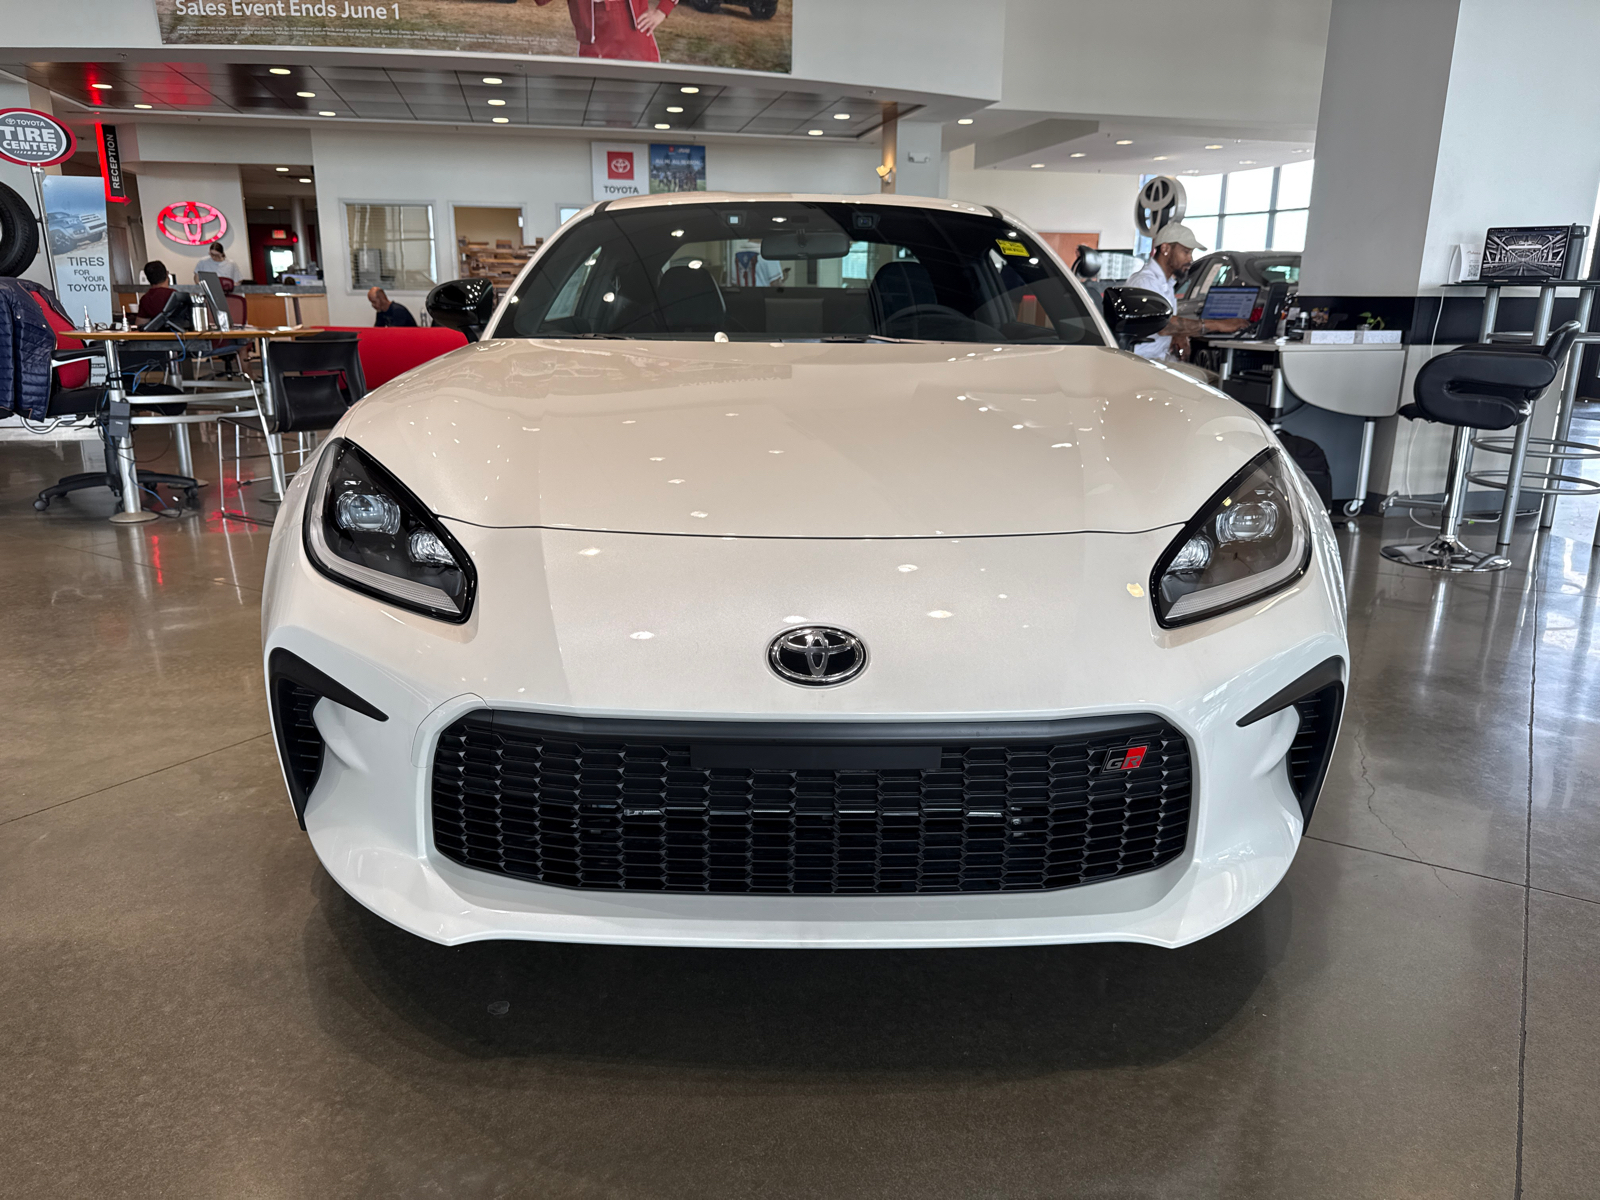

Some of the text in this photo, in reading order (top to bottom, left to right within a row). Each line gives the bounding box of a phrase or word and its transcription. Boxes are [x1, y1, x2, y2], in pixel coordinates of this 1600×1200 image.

[175, 0, 399, 20] Sales Event Ends June 1
[16, 119, 46, 127] TOYOTA
[0, 126, 57, 143] TIRE
[2, 140, 58, 152] CENTER
[106, 134, 121, 189] RECEPTION
[604, 185, 639, 195] TOYOTA
[67, 256, 105, 267] TIRES
[66, 283, 109, 292] TOYOTA
[1105, 756, 1141, 770] GR
